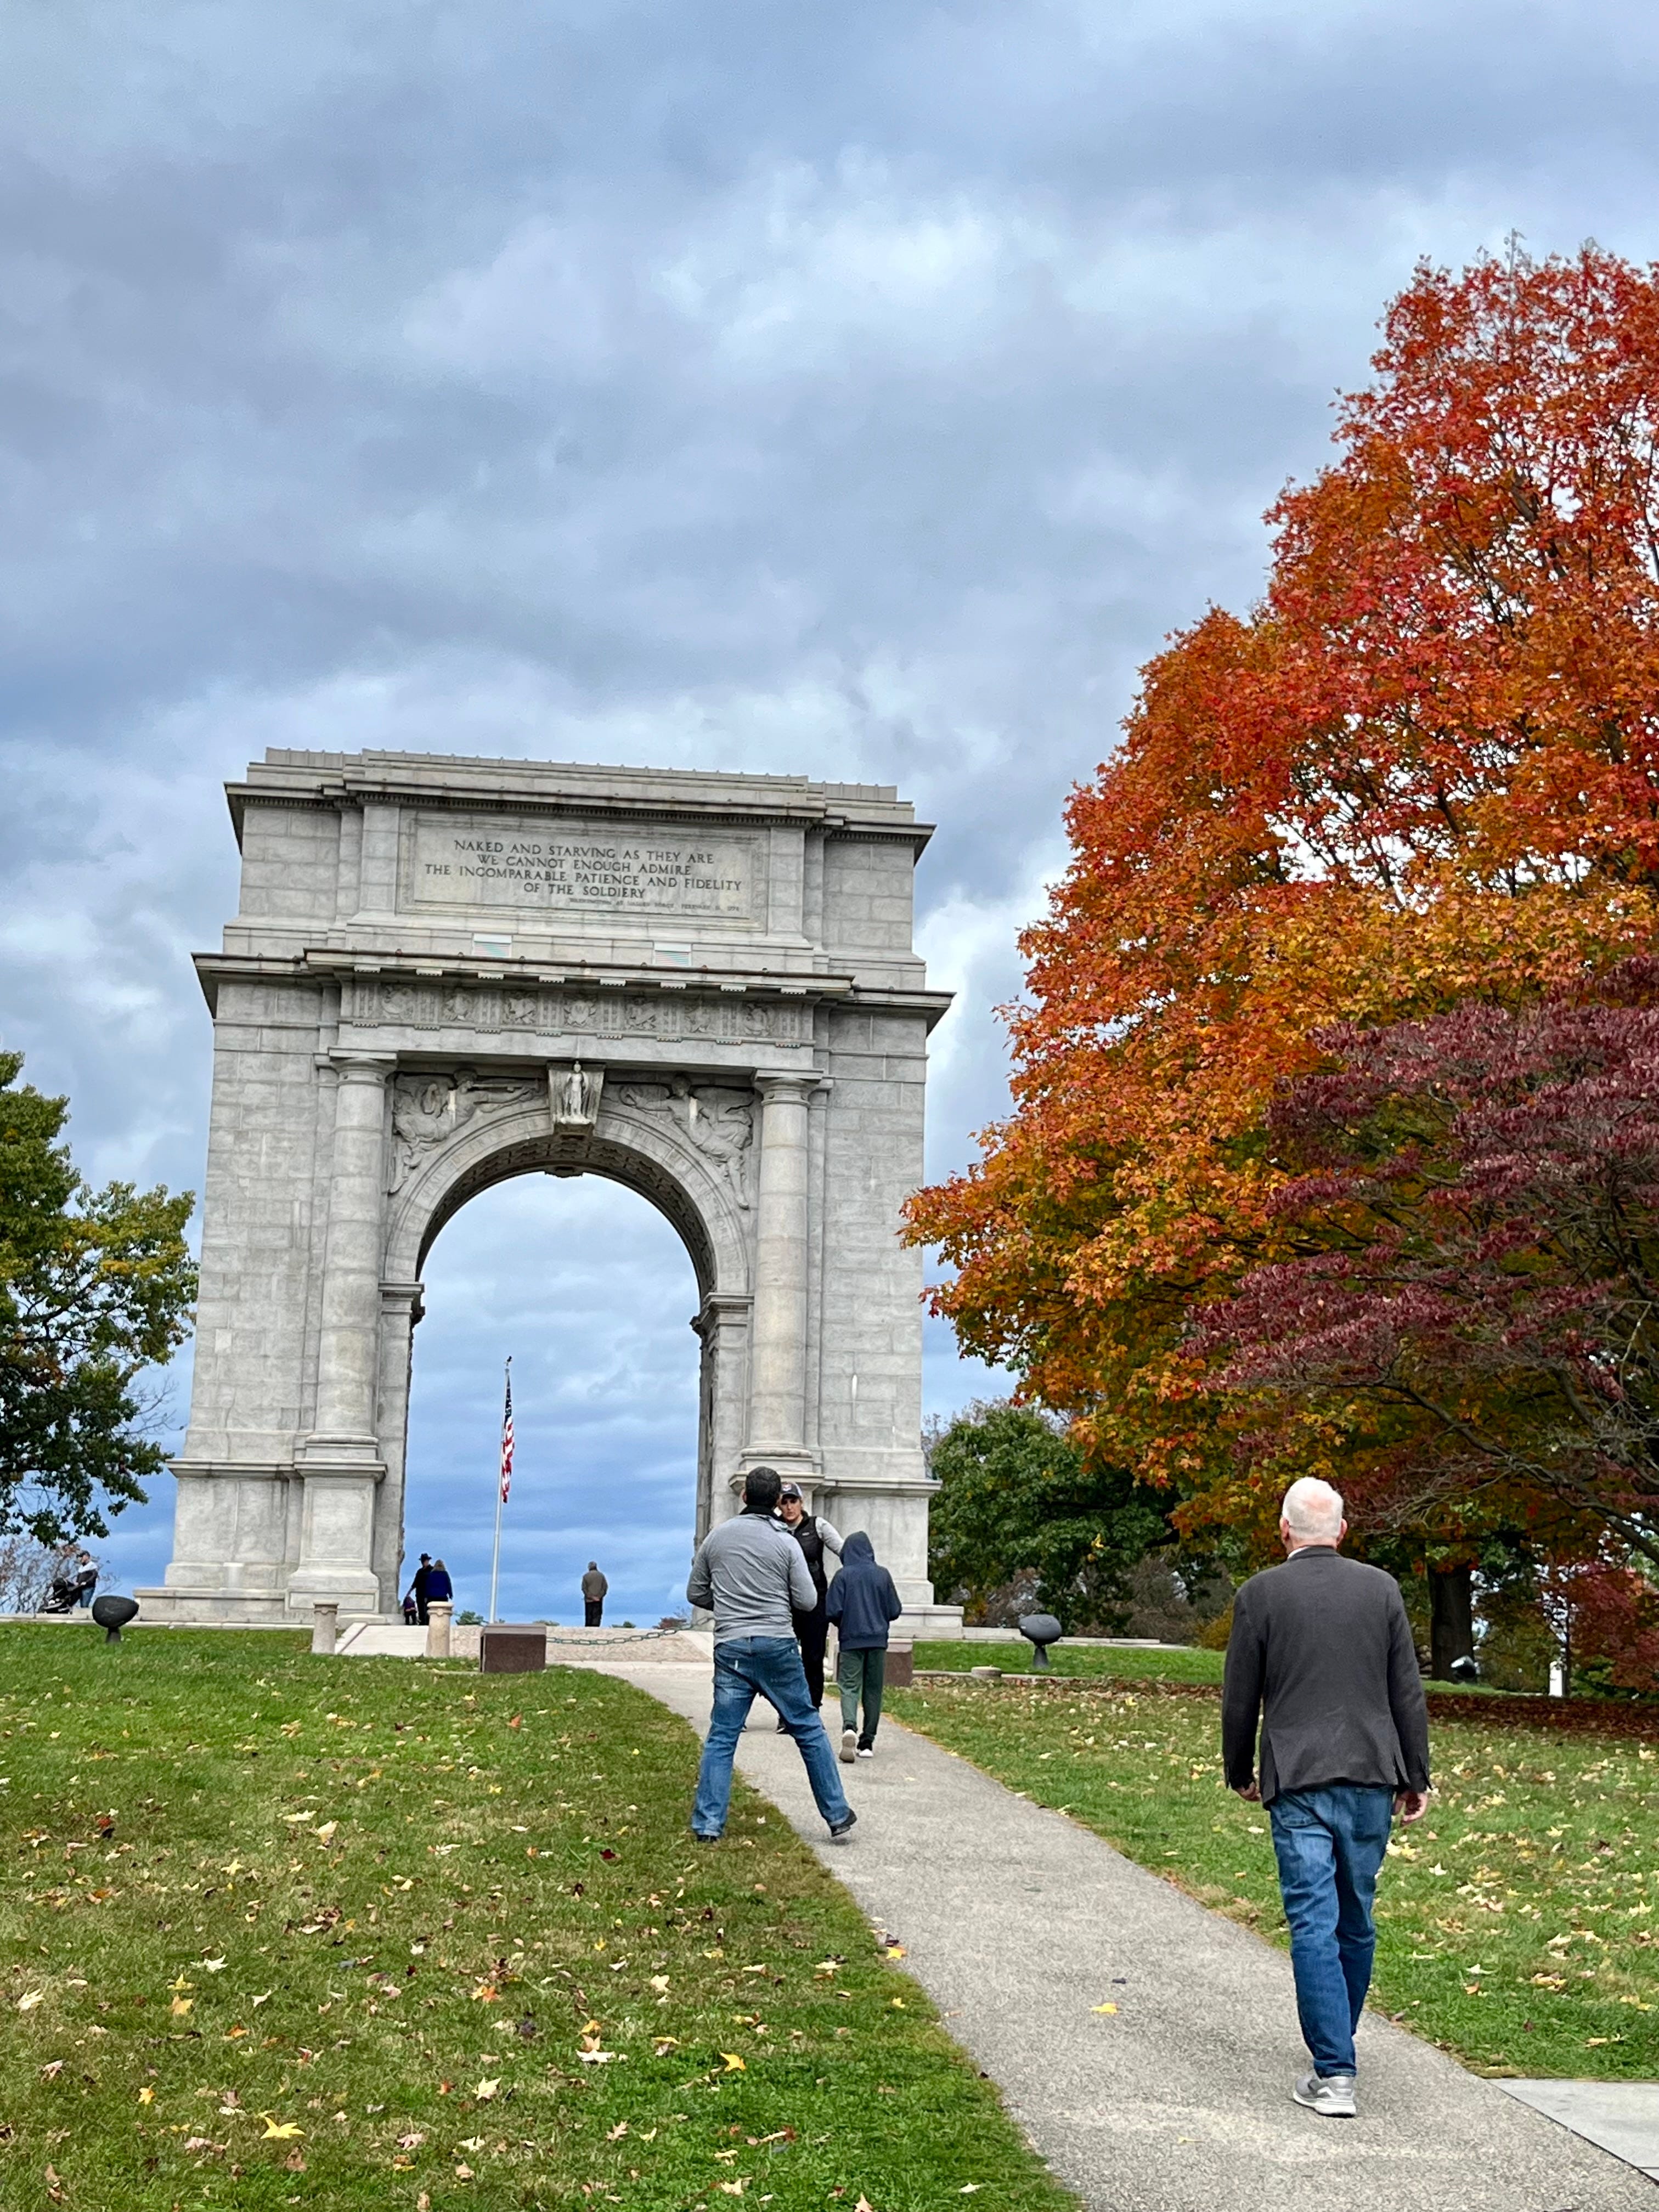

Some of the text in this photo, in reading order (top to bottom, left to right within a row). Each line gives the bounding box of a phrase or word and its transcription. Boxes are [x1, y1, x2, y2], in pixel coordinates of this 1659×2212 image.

[454, 839, 714, 865] NAKED AND STARVING AS THEY ARE
[477, 854, 691, 876] WE CANNOT ENOUGH ADMIRE
[425, 864, 742, 891] THE INCOMPARABLE PATIENCE AND FIDELITY
[524, 882, 646, 899] OF THE SOLDIERY
